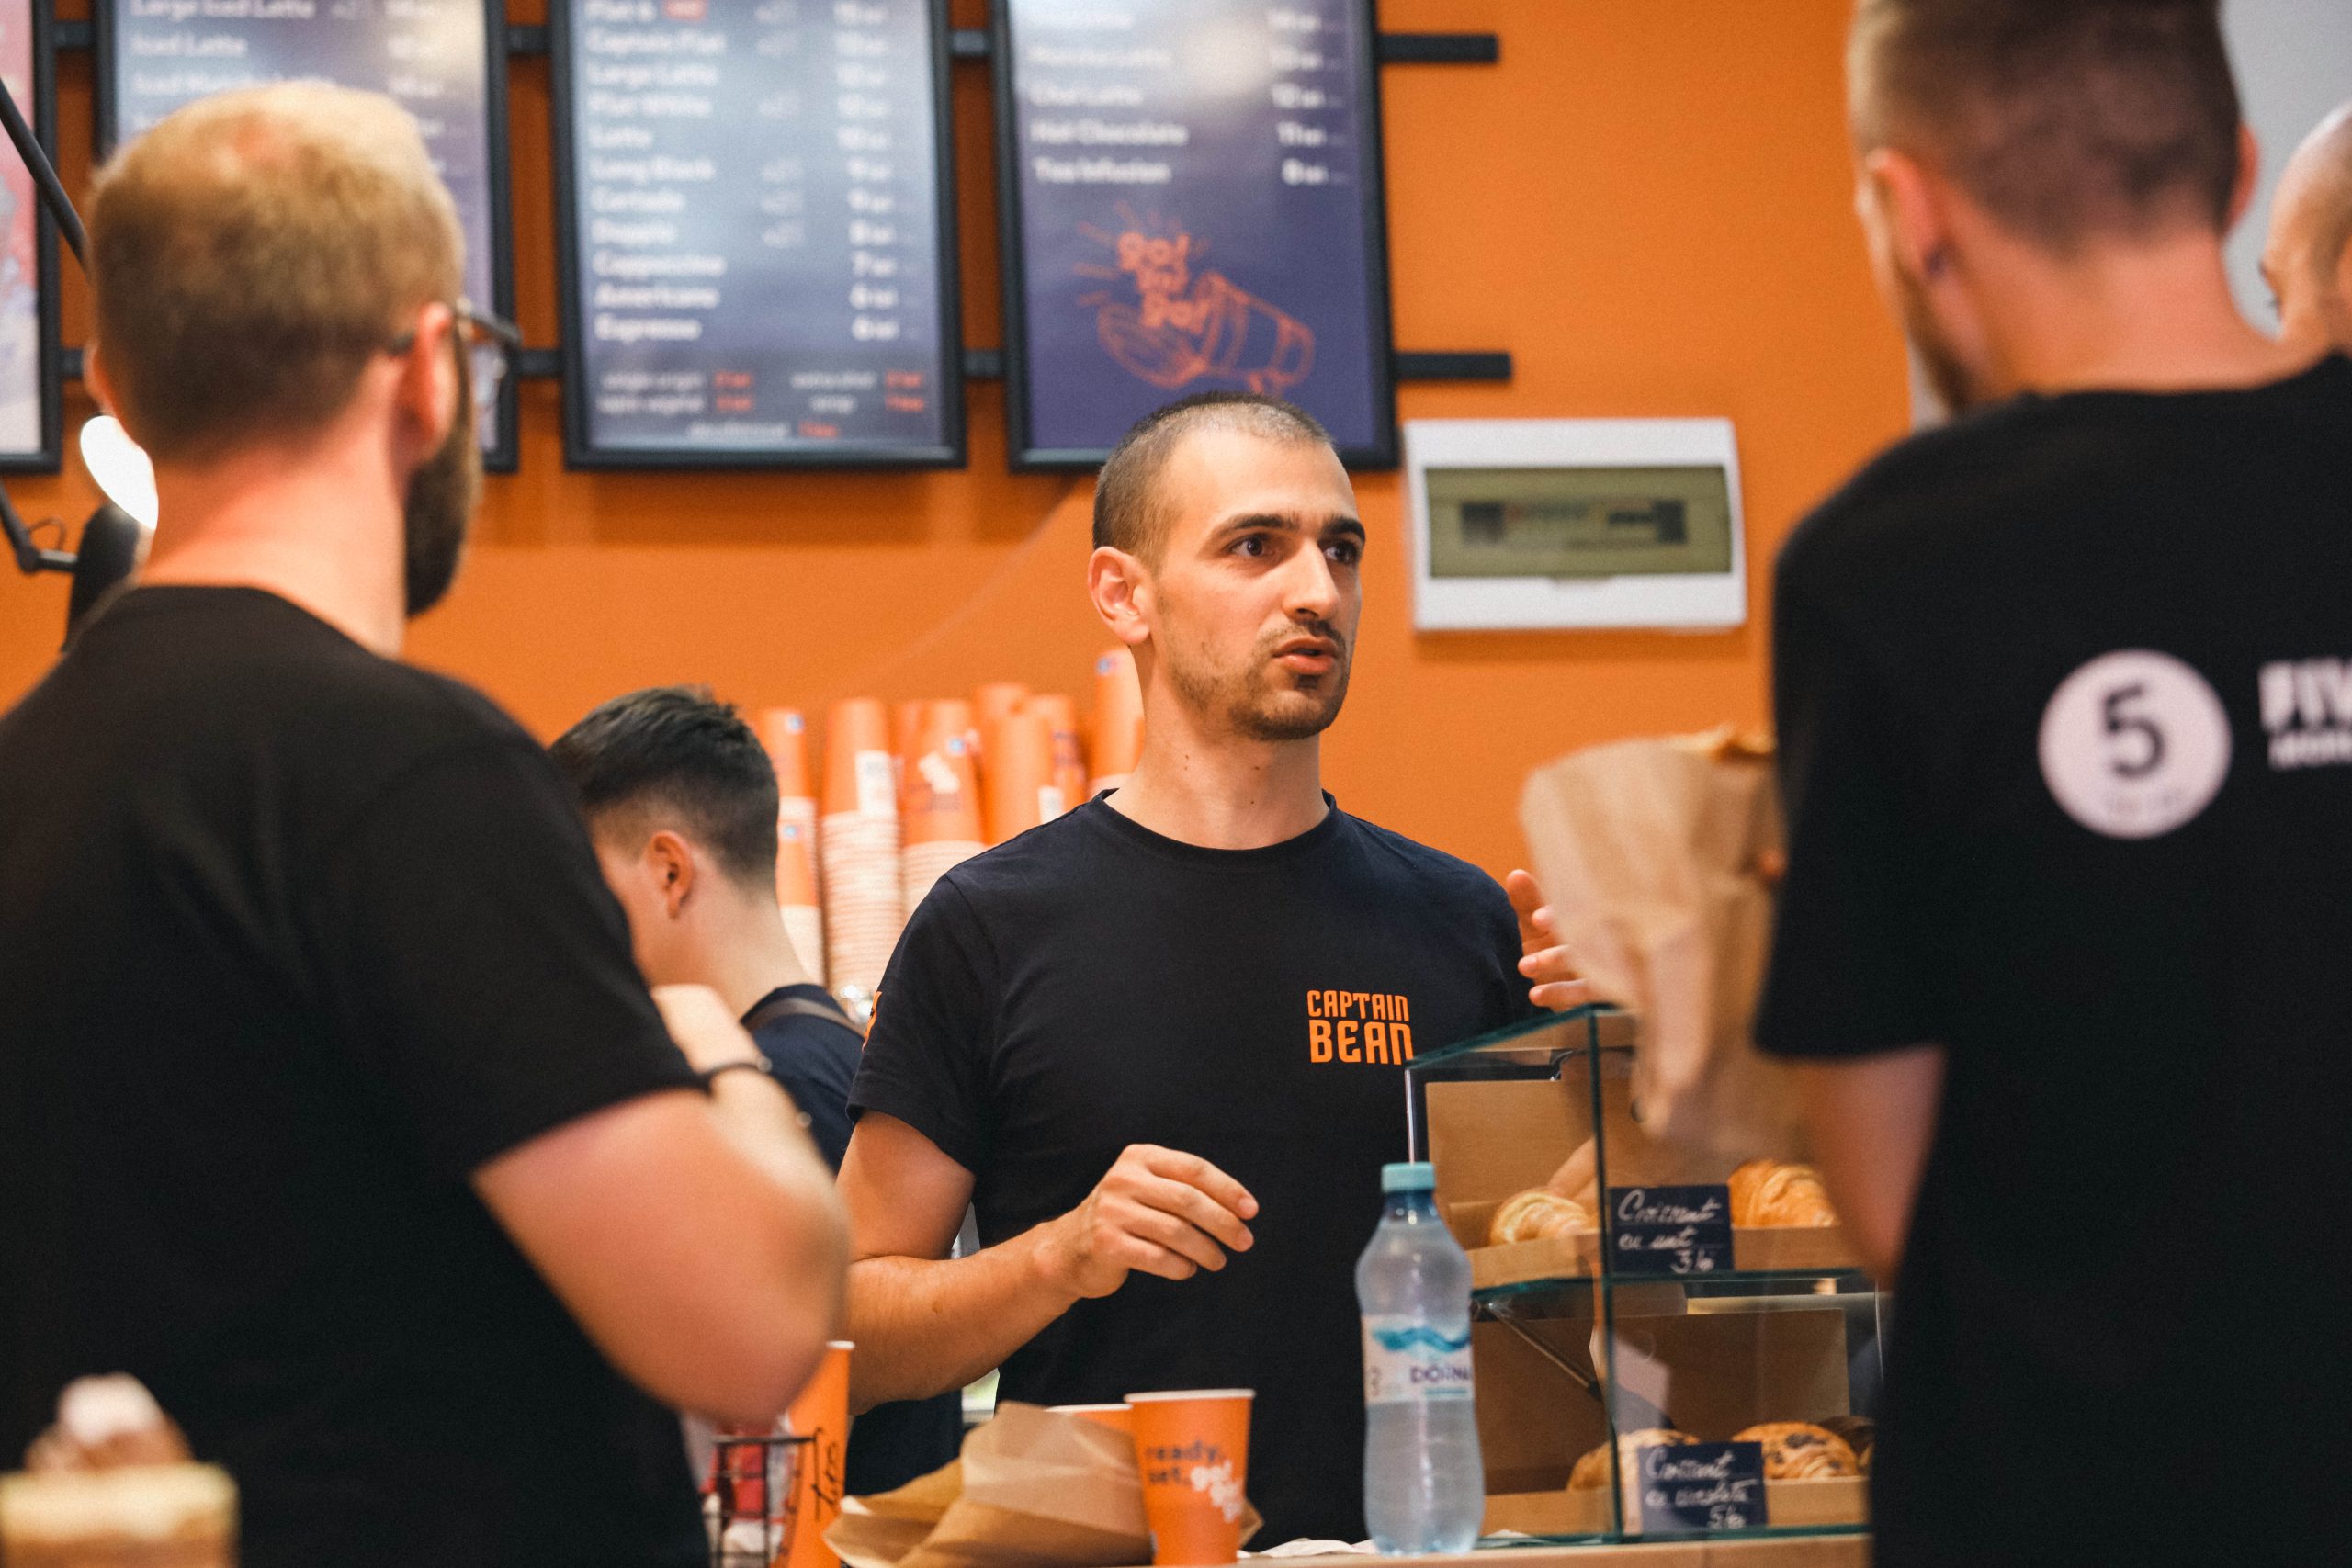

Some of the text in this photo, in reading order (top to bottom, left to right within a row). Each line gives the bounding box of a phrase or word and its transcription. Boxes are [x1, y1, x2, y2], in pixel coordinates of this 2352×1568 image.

[2103, 681, 2165, 783] 5
[1307, 990, 1409, 1021] CAPTAIN
[1308, 1019, 1414, 1066] BEAN
